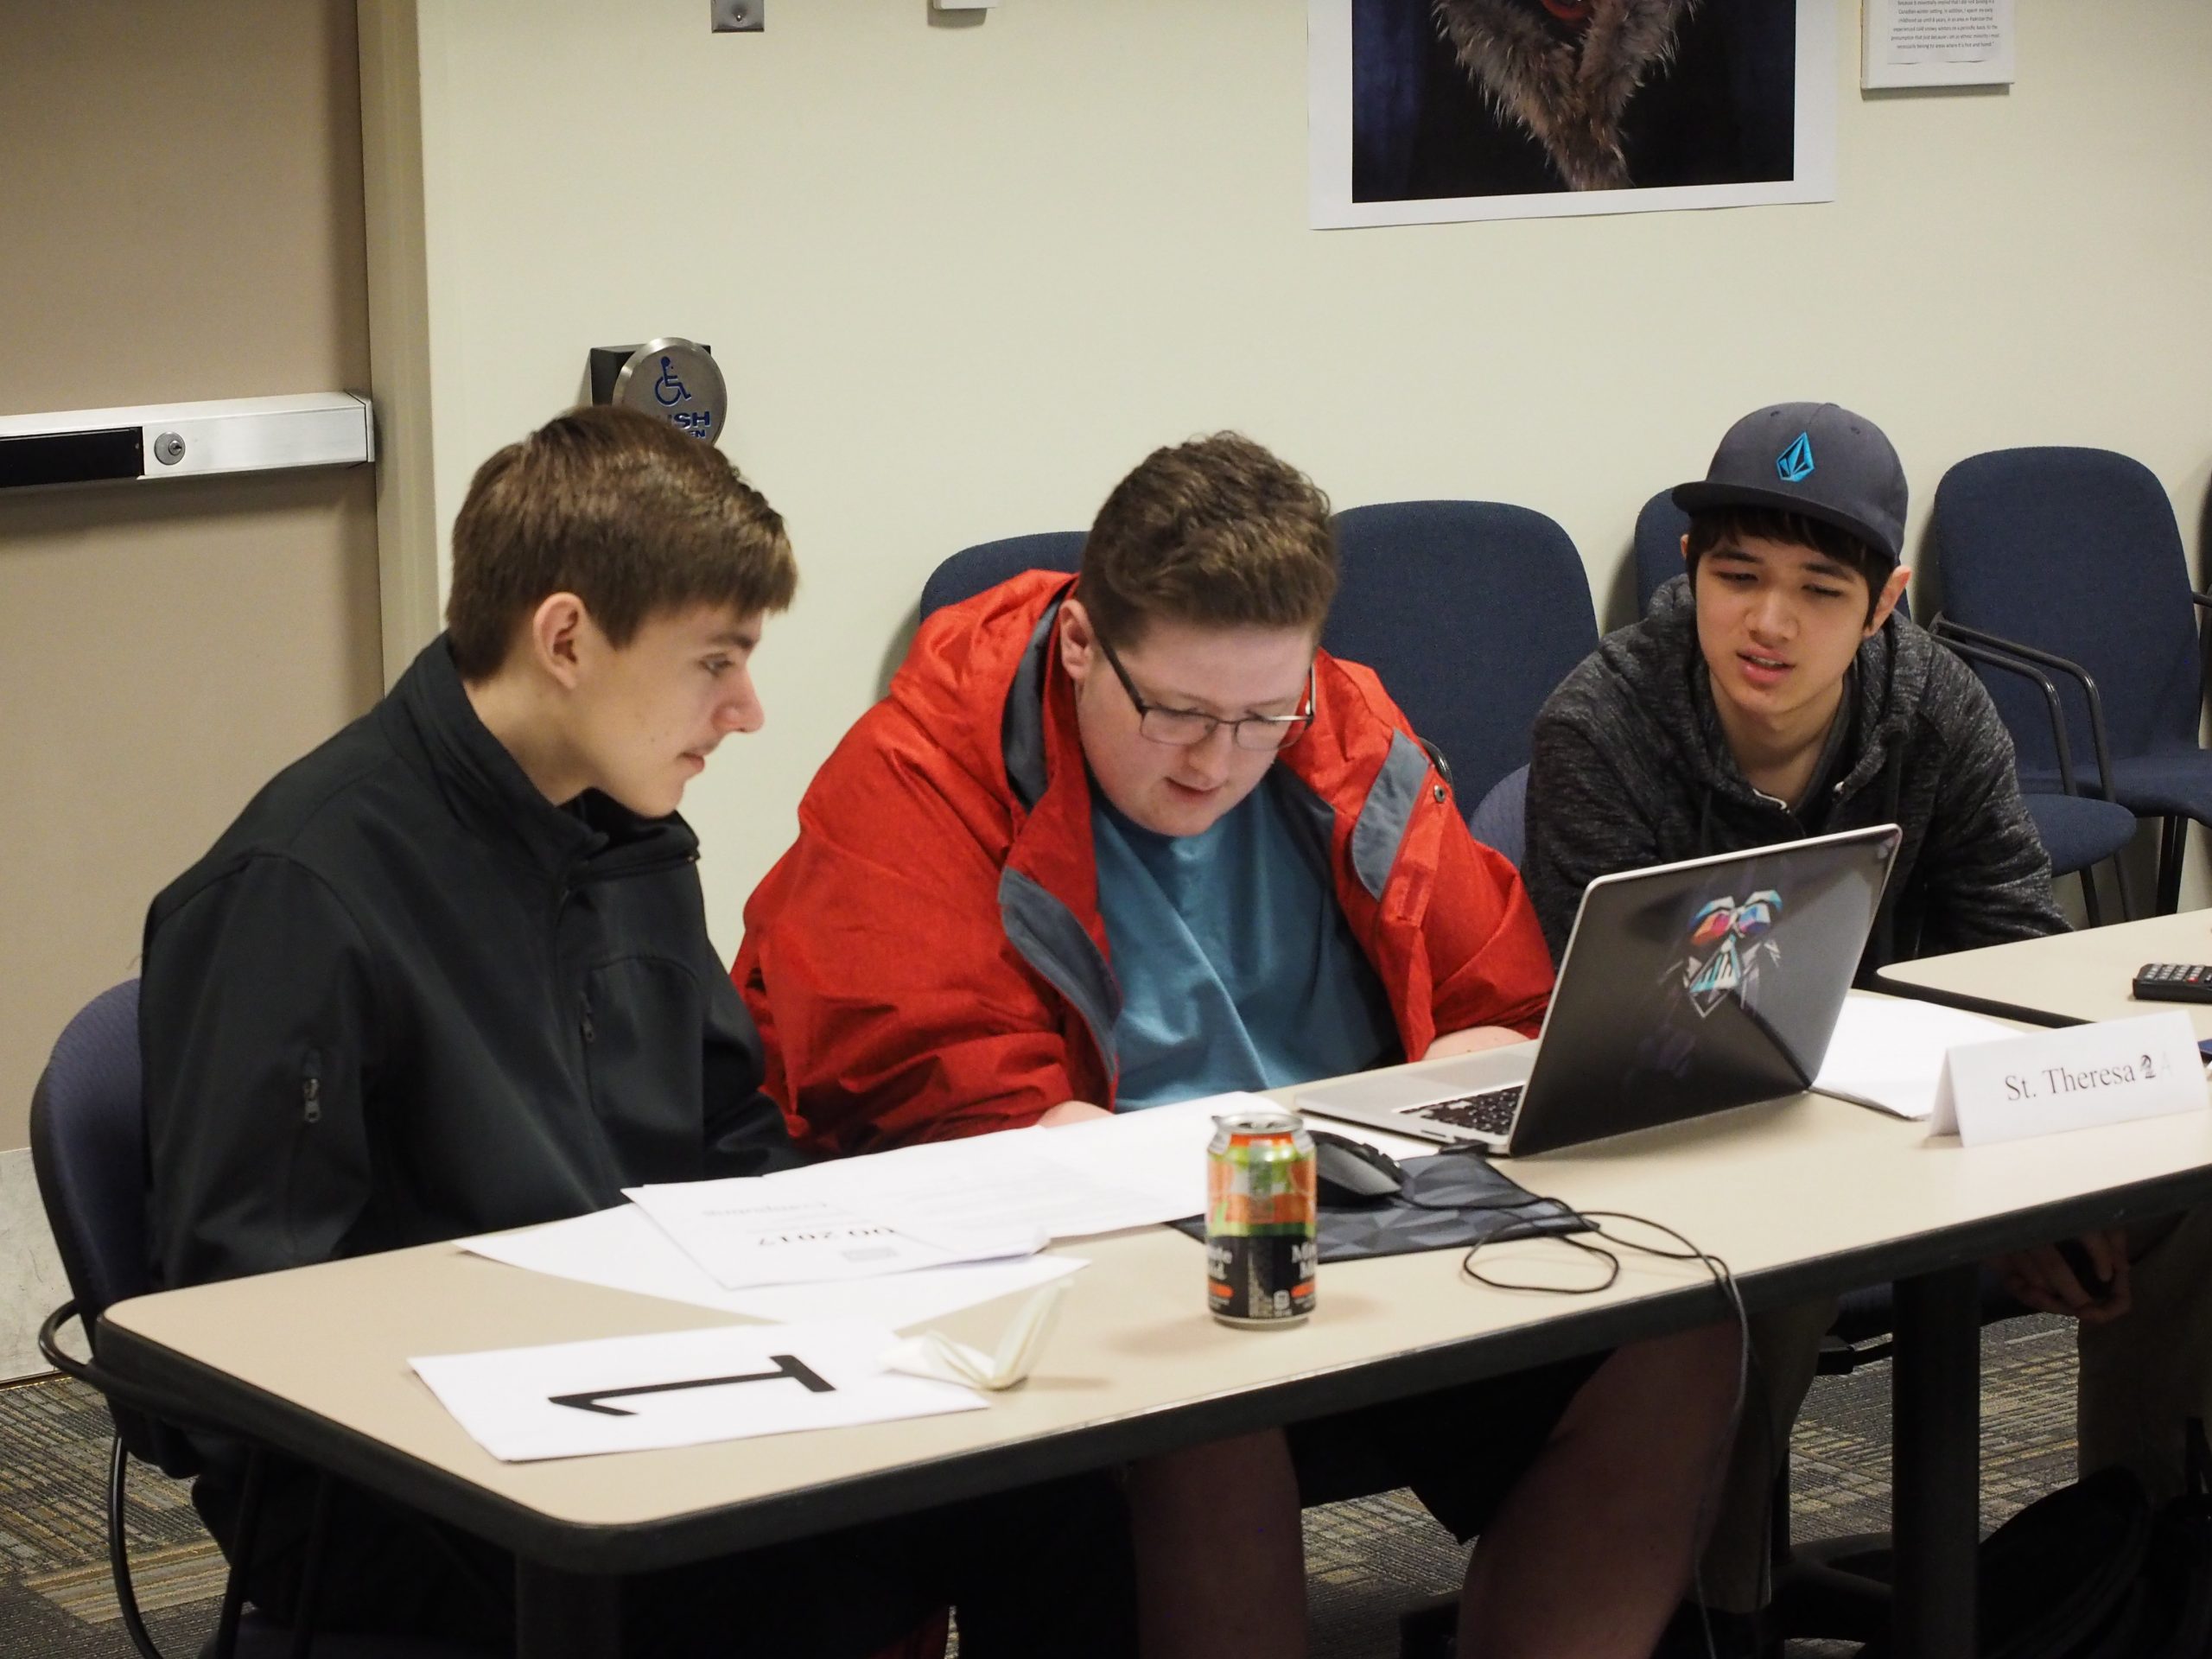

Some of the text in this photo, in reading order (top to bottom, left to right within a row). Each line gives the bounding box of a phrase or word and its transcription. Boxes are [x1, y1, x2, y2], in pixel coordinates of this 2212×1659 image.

[671, 410, 710, 429] SH
[2004, 1075, 2037, 1102] St.
[2042, 1065, 2137, 1095] Theresa
[758, 1230, 840, 1246] 2017
[548, 1355, 836, 1416] 1
